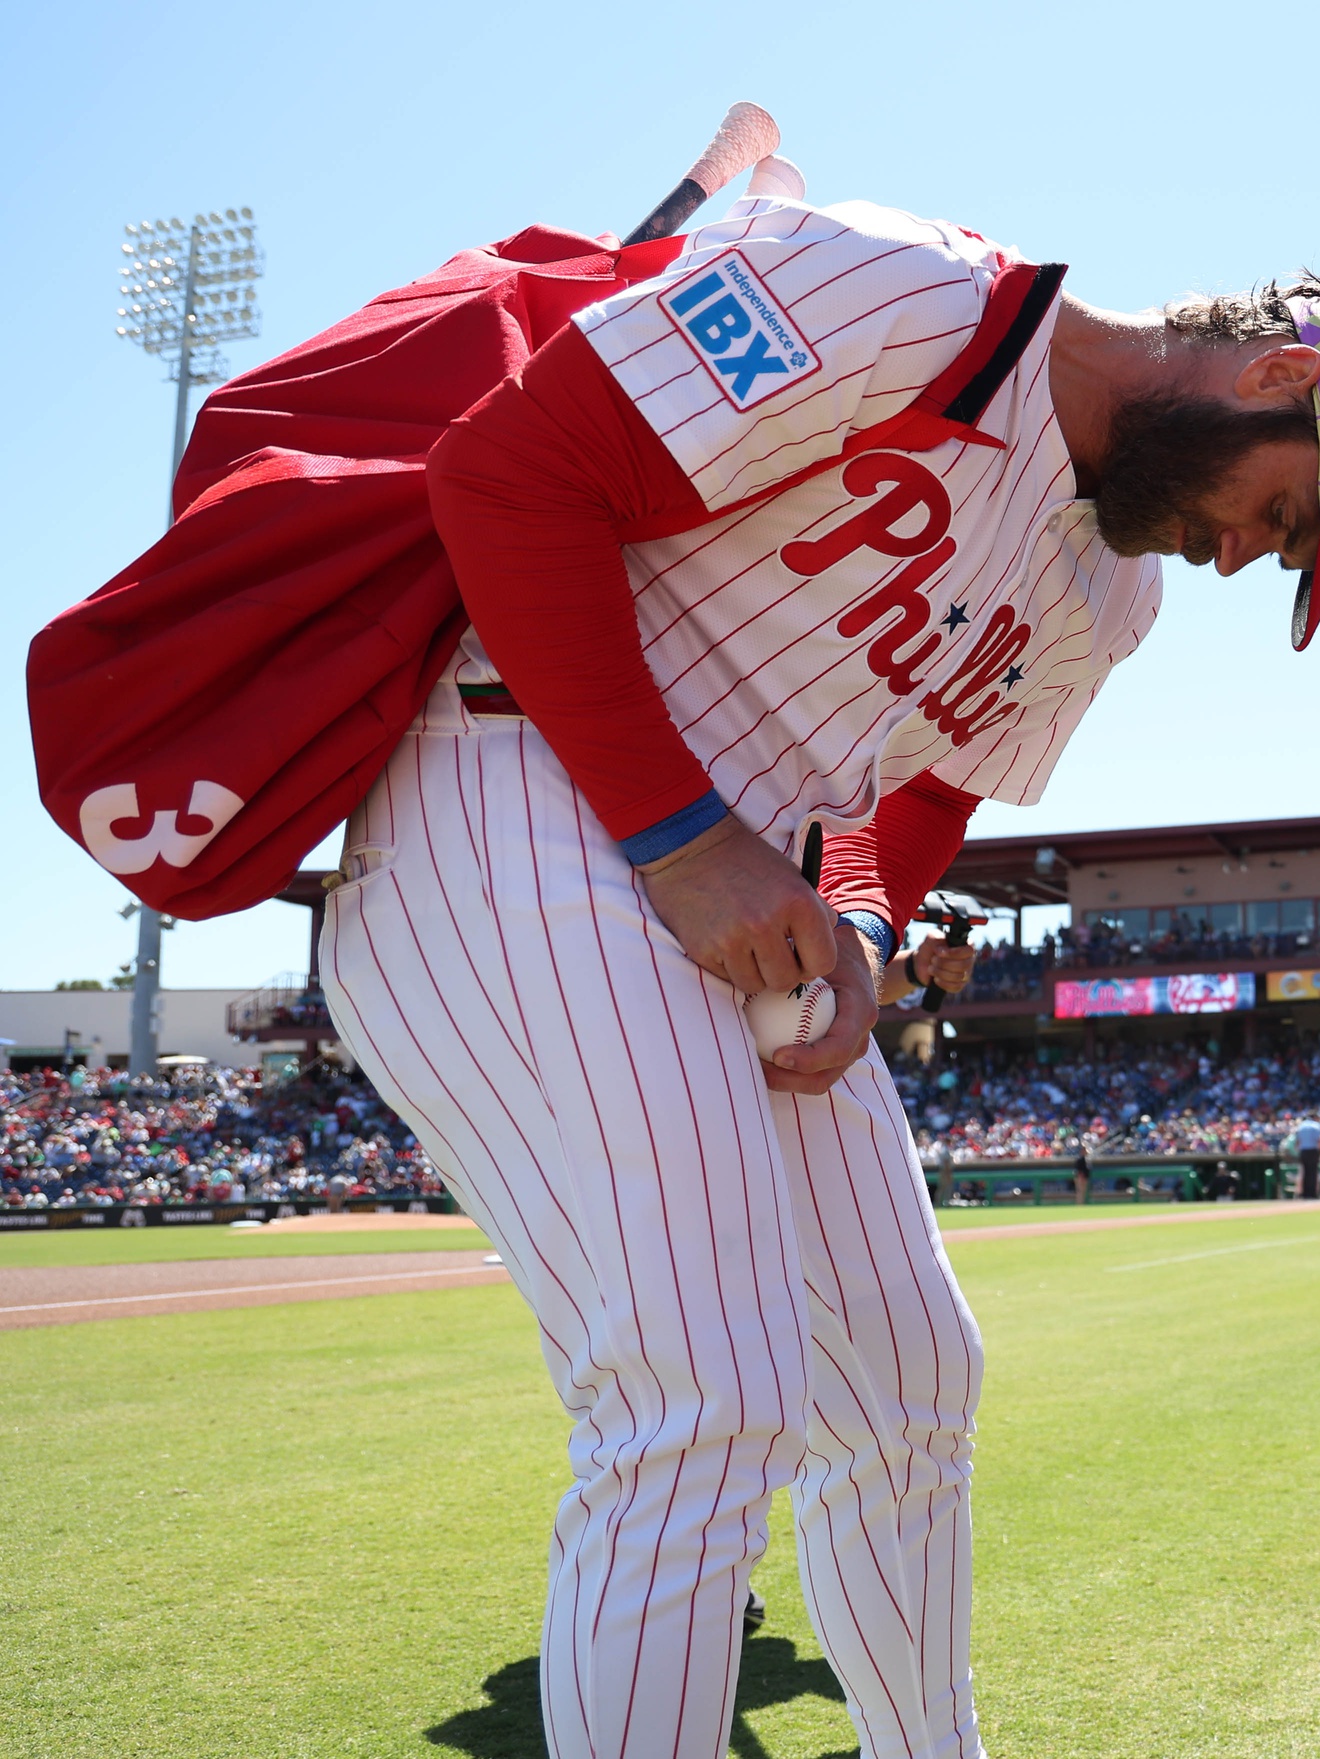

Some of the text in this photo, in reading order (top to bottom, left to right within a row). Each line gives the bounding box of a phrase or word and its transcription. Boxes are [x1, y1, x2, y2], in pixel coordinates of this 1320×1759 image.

[669, 271, 790, 402] IBX
[724, 260, 795, 351] Independence
[779, 448, 1032, 751] Phillie
[79, 779, 246, 876] 3
